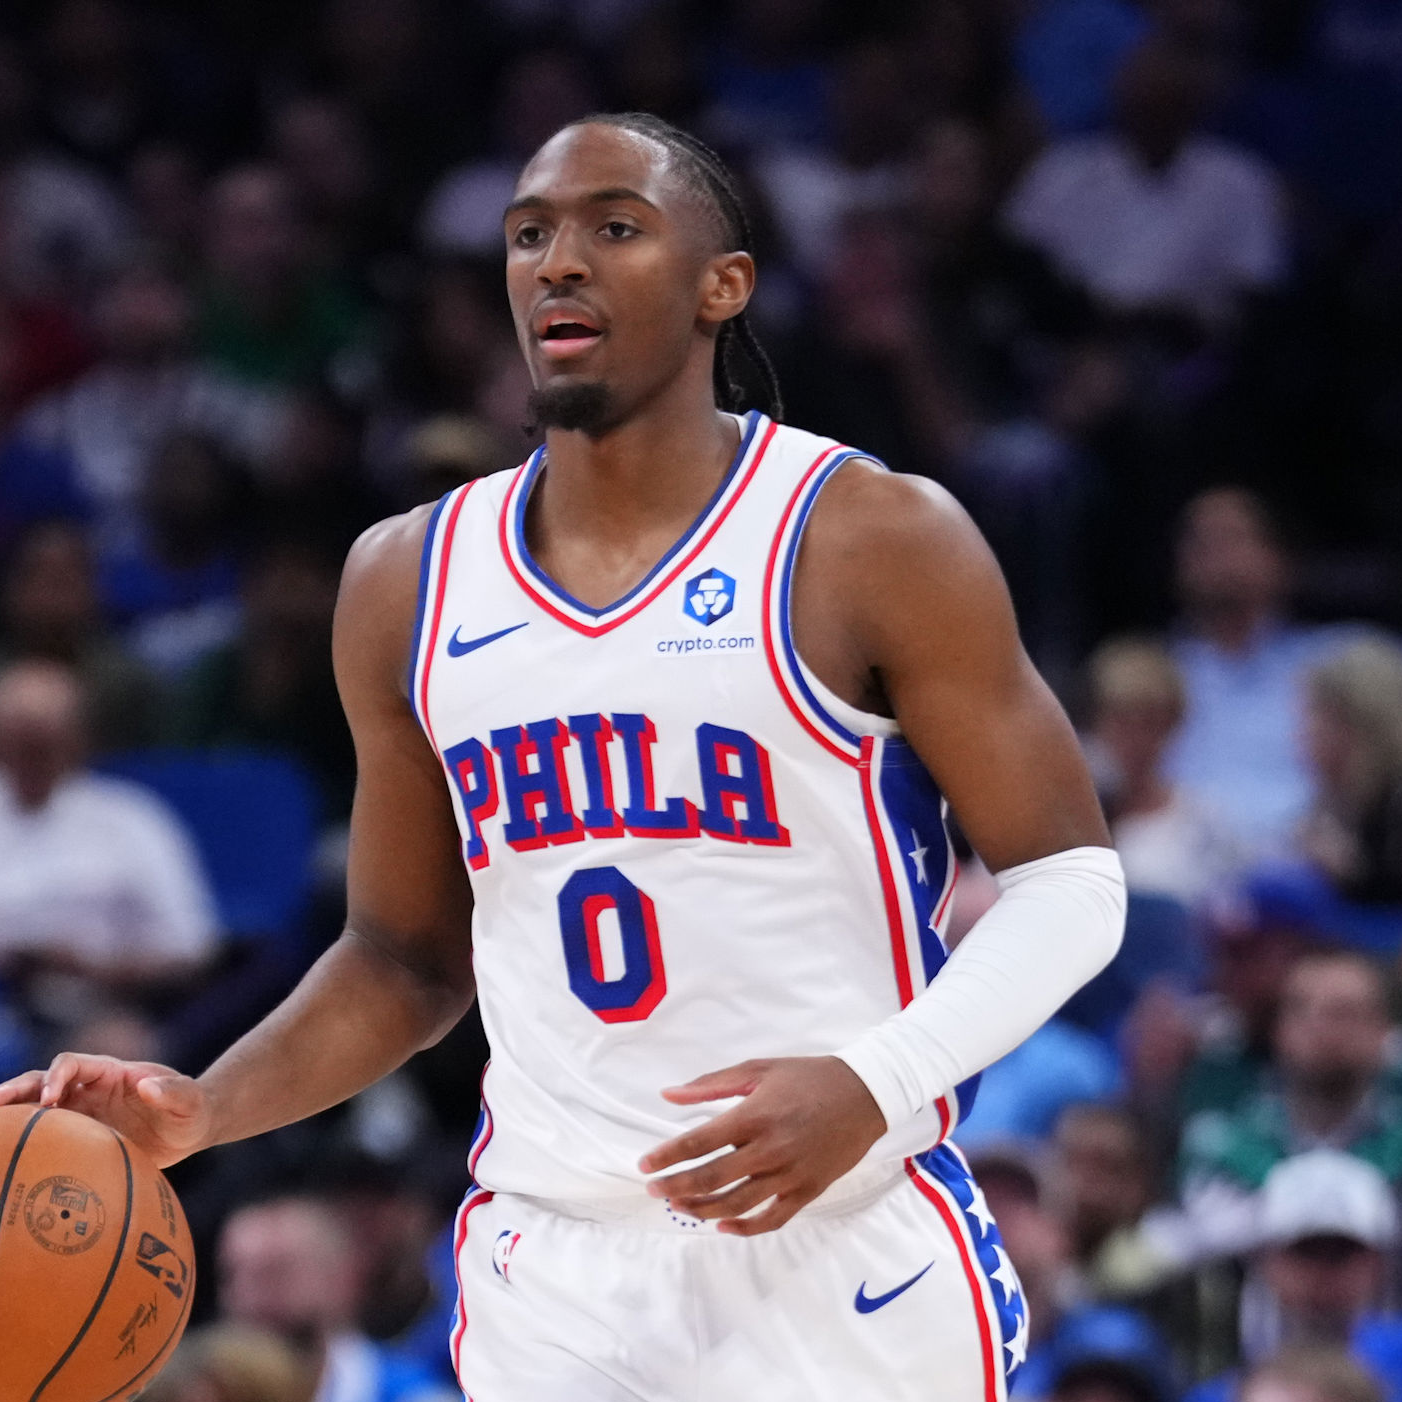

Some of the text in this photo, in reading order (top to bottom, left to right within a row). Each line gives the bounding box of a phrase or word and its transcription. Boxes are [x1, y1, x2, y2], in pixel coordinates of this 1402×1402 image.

[657, 636, 755, 653] crypto.com
[443, 712, 792, 872] PHILA
[557, 866, 667, 1024] 0
